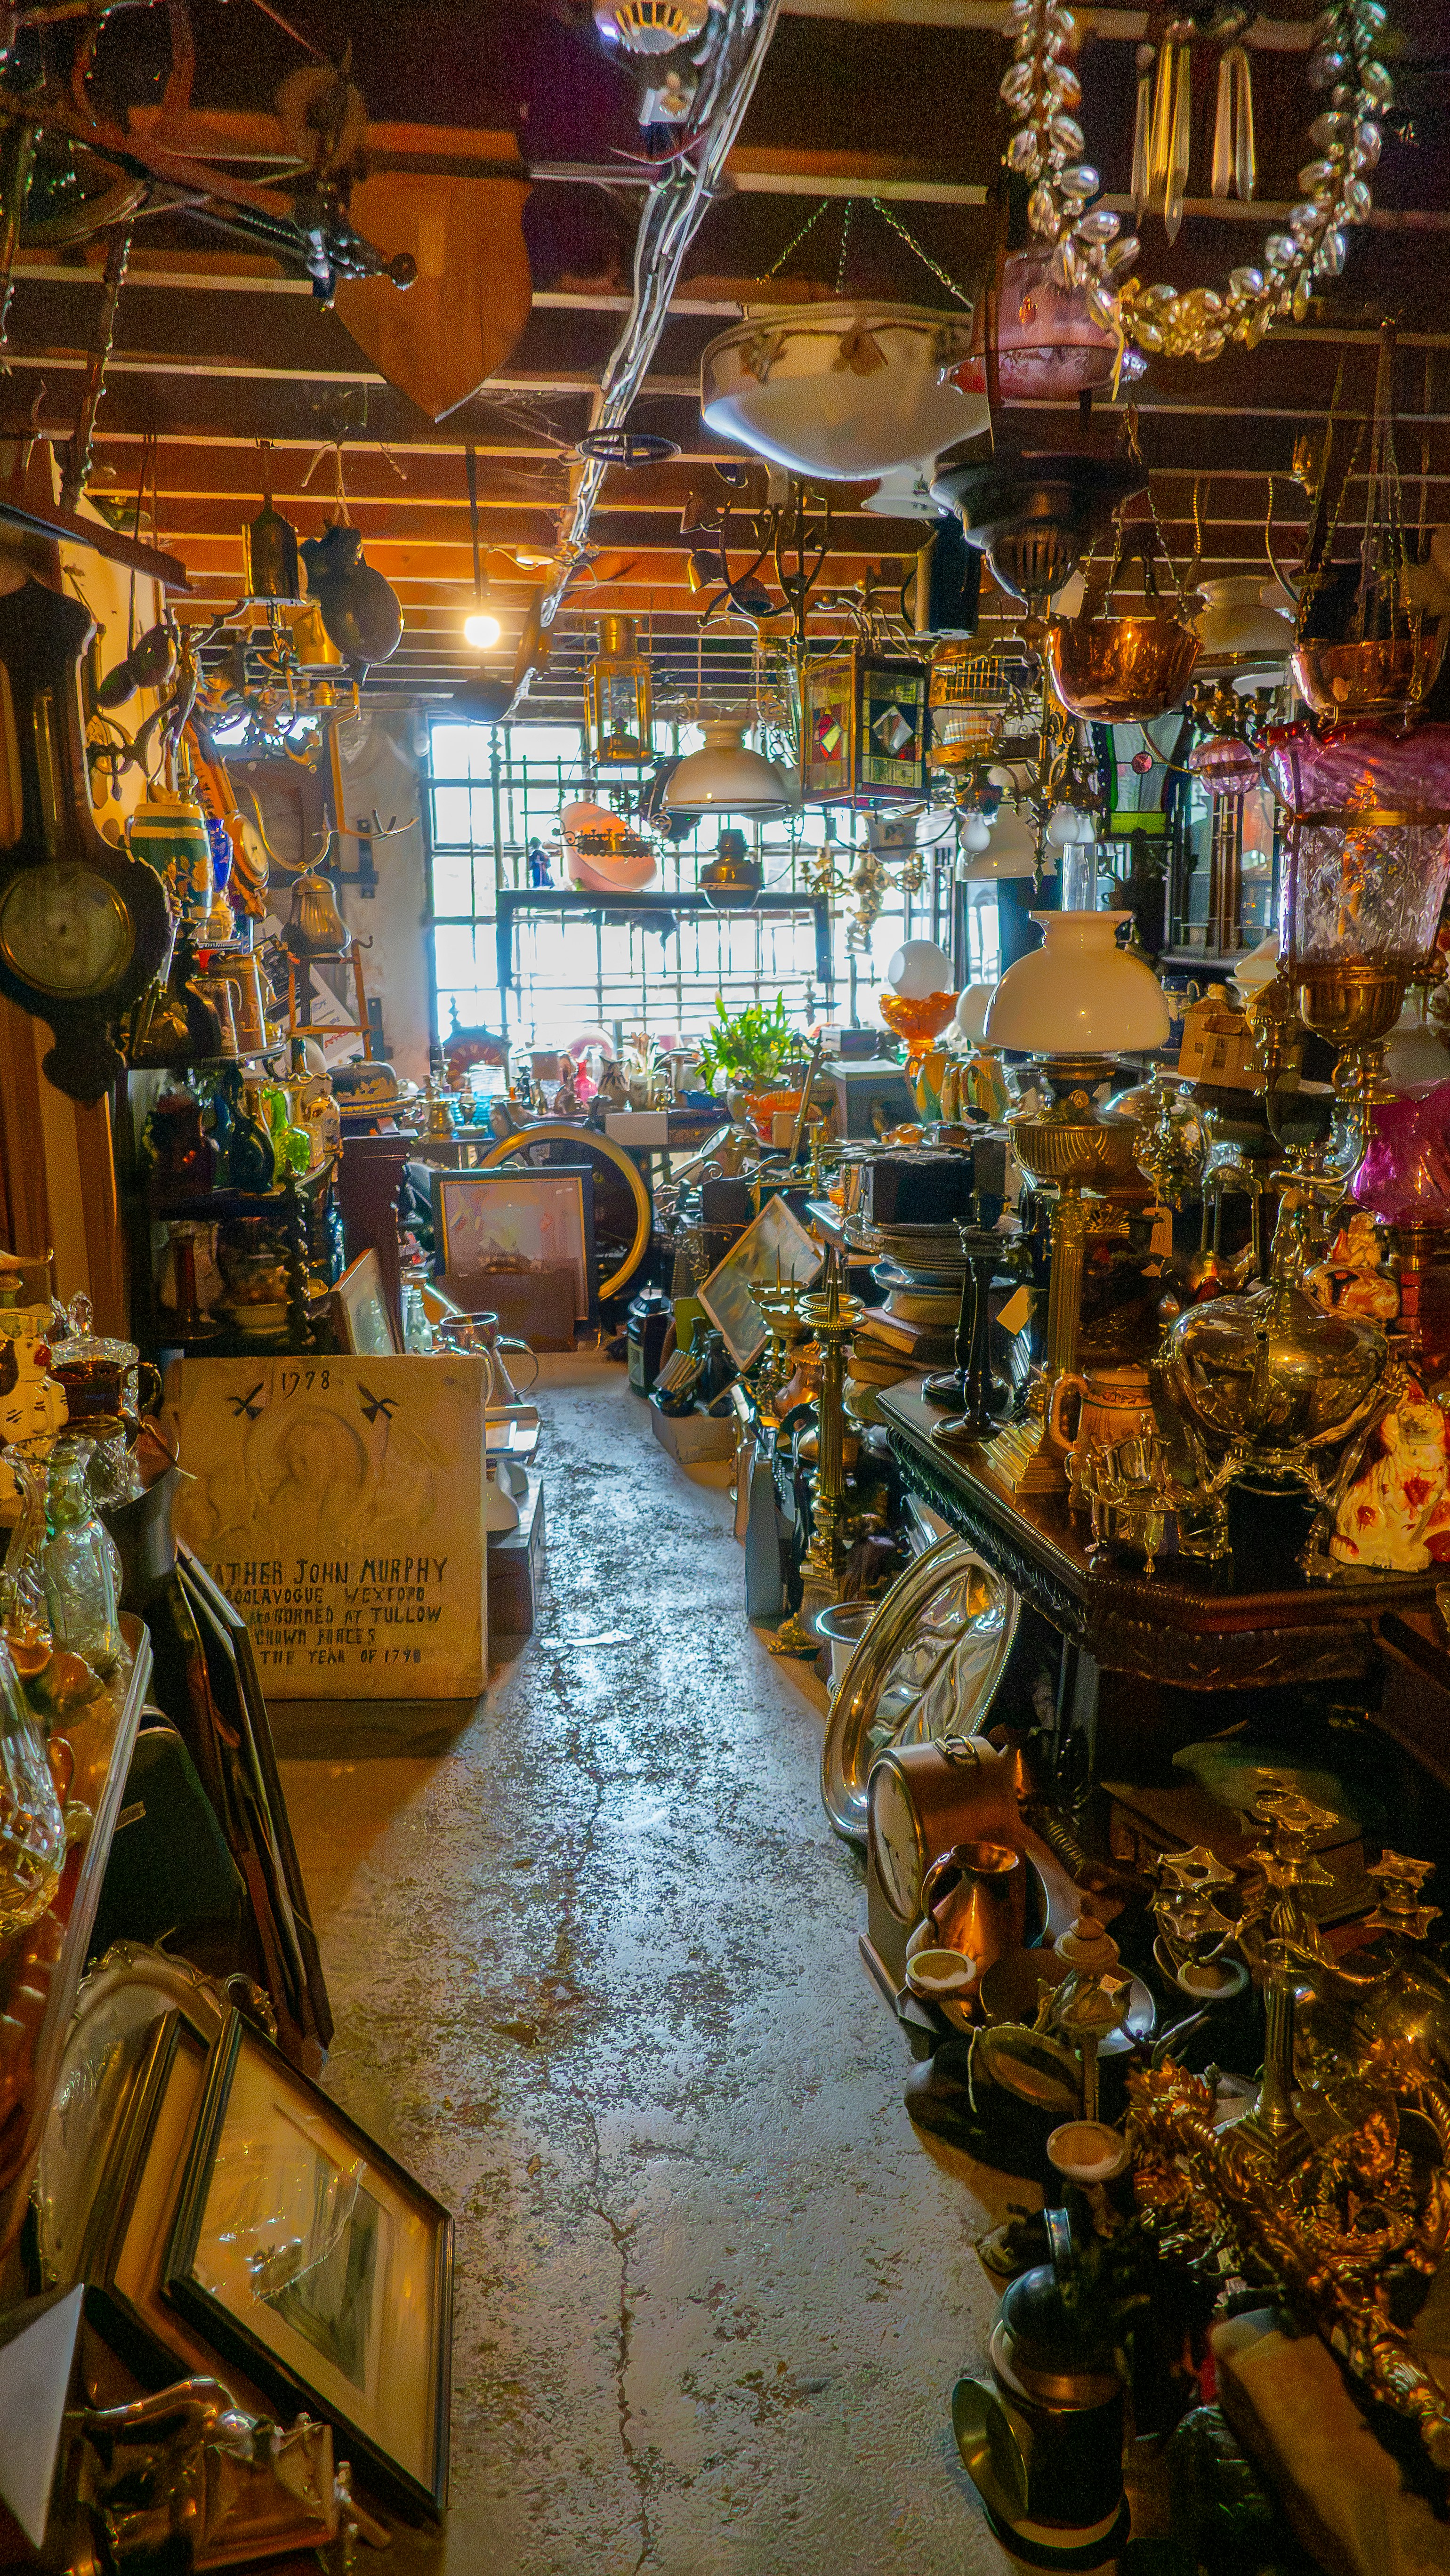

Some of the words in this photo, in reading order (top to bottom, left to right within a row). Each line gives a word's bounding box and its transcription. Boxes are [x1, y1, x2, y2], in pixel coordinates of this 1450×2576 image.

[203, 1561, 282, 1585] ATHER
[294, 1558, 348, 1584] JOHN
[359, 1557, 447, 1583] MURPHY
[345, 1610, 362, 1625] AT
[370, 1605, 442, 1623] TULLOW
[360, 1649, 377, 1664] OF
